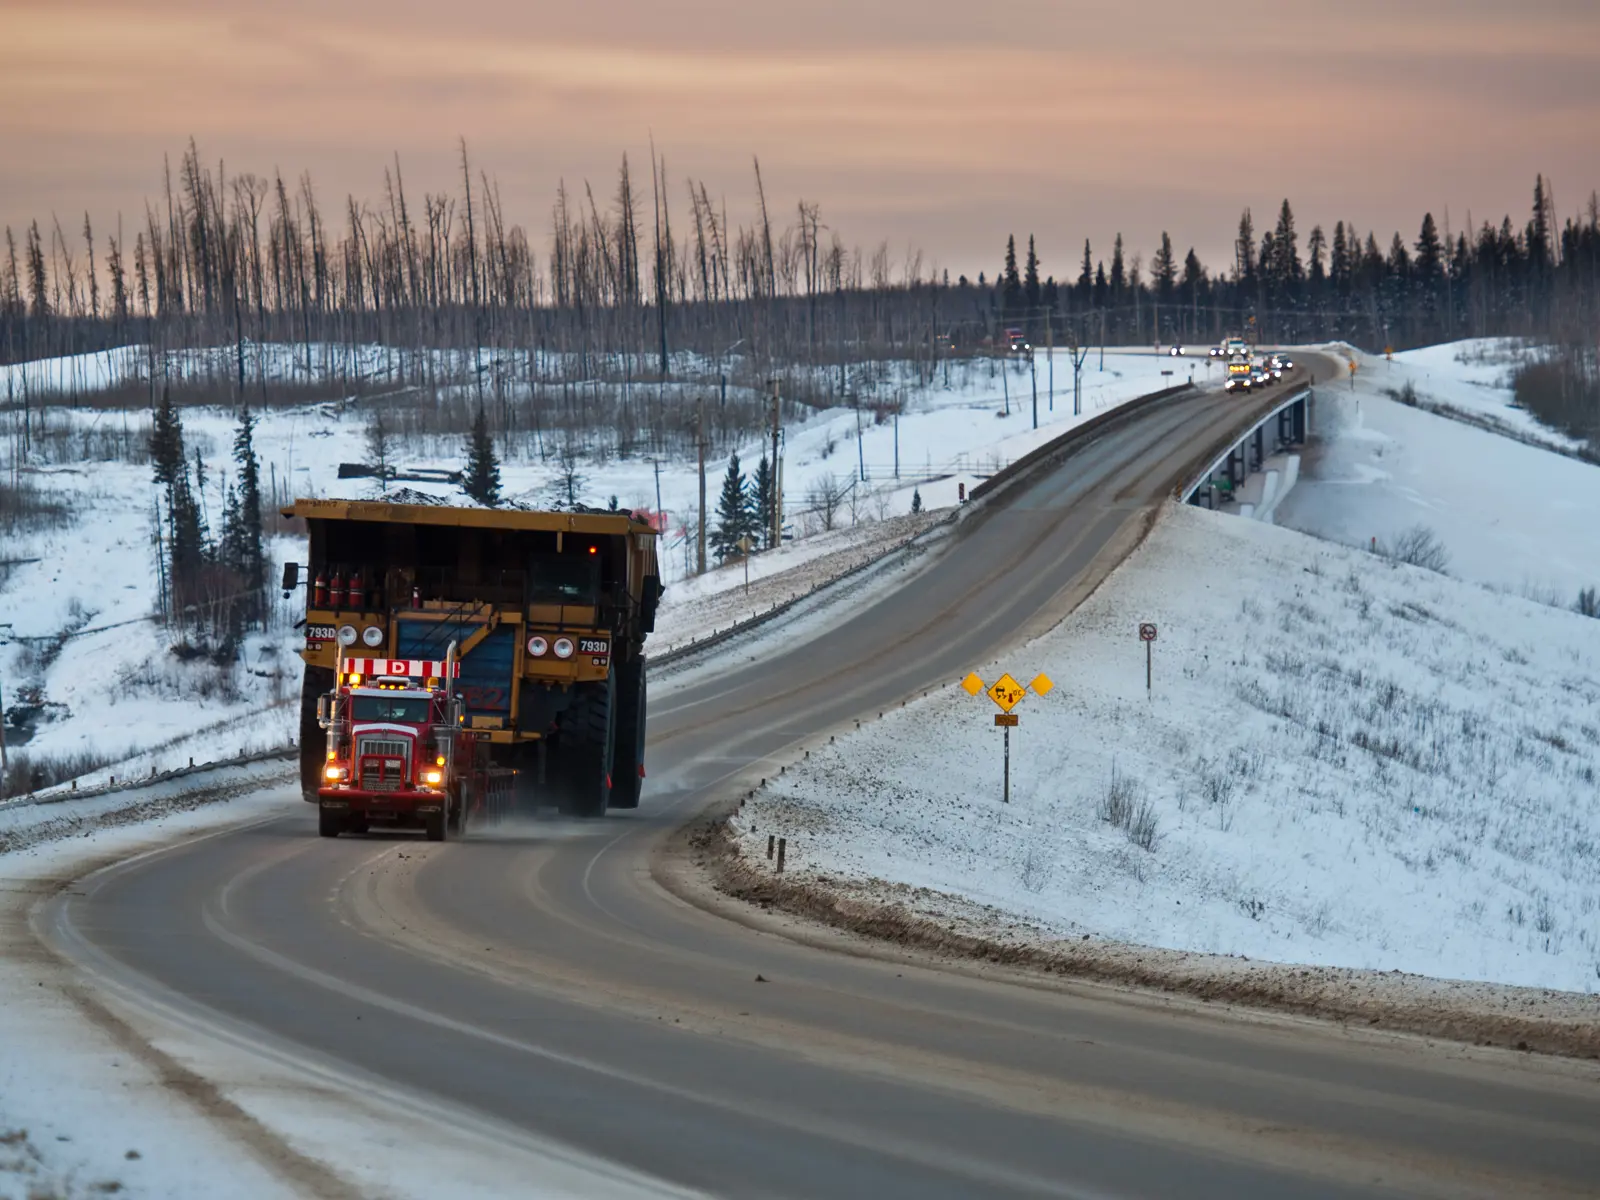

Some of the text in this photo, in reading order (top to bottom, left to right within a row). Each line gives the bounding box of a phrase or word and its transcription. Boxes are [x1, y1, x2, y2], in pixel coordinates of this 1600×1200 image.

[309, 627, 336, 638] 793D
[581, 640, 607, 653] 793D
[392, 661, 405, 674] D
